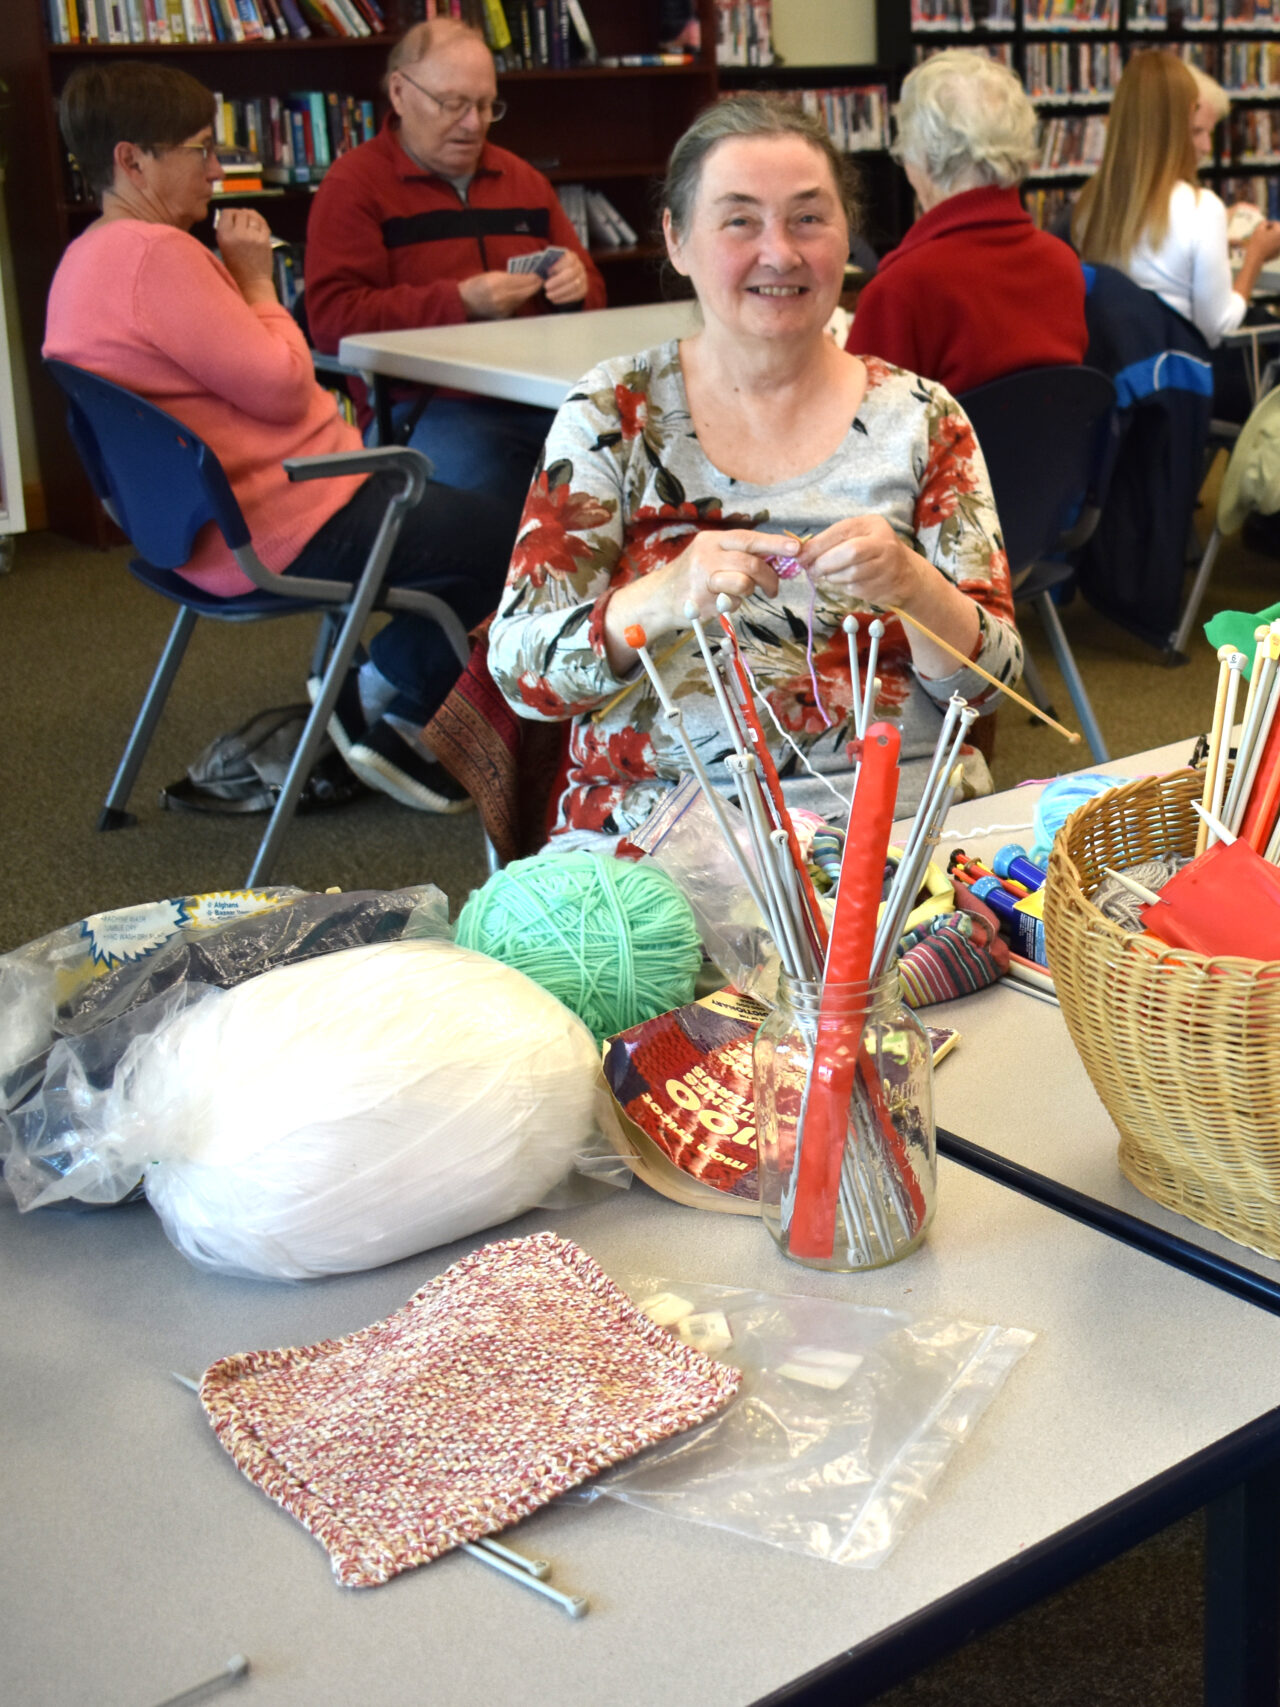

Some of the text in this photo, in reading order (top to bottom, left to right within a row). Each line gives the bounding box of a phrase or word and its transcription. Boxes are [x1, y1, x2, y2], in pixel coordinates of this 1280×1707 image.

[665, 1078, 758, 1150] 100
[691, 1065, 755, 1111] TERNS
[641, 1093, 748, 1170] mon tricot
